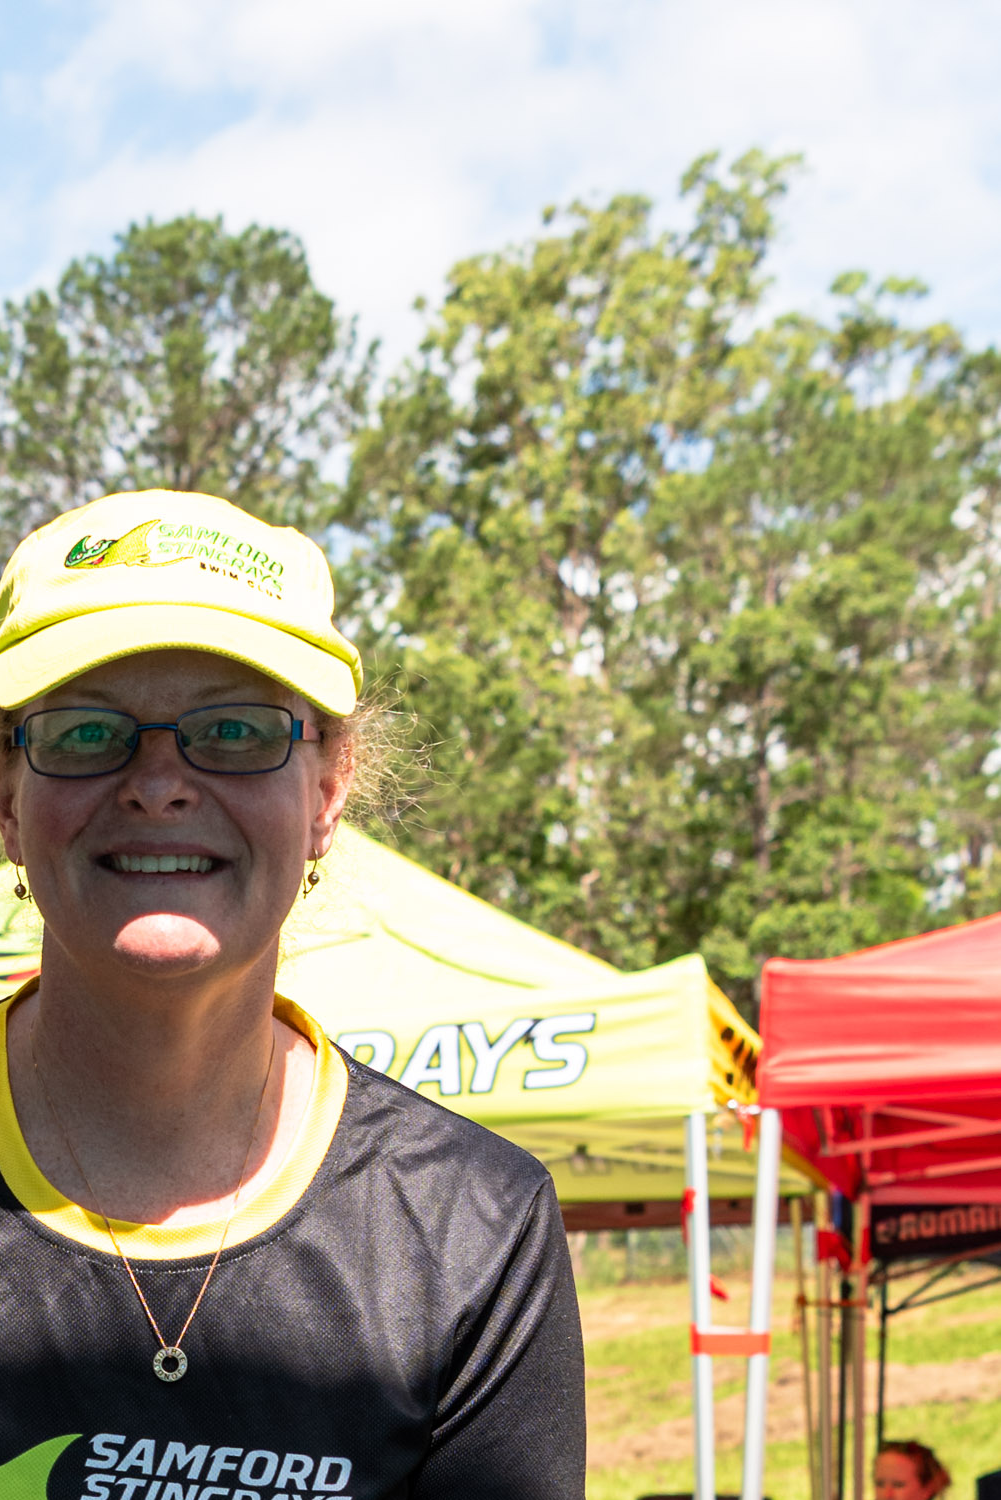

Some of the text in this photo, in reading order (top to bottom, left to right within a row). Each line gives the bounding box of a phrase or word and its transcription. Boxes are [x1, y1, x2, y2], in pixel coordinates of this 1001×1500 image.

[158, 523, 284, 577] SAMFORD
[158, 541, 283, 592] STINGRAYS
[84, 1432, 353, 1492] SAMFORD
